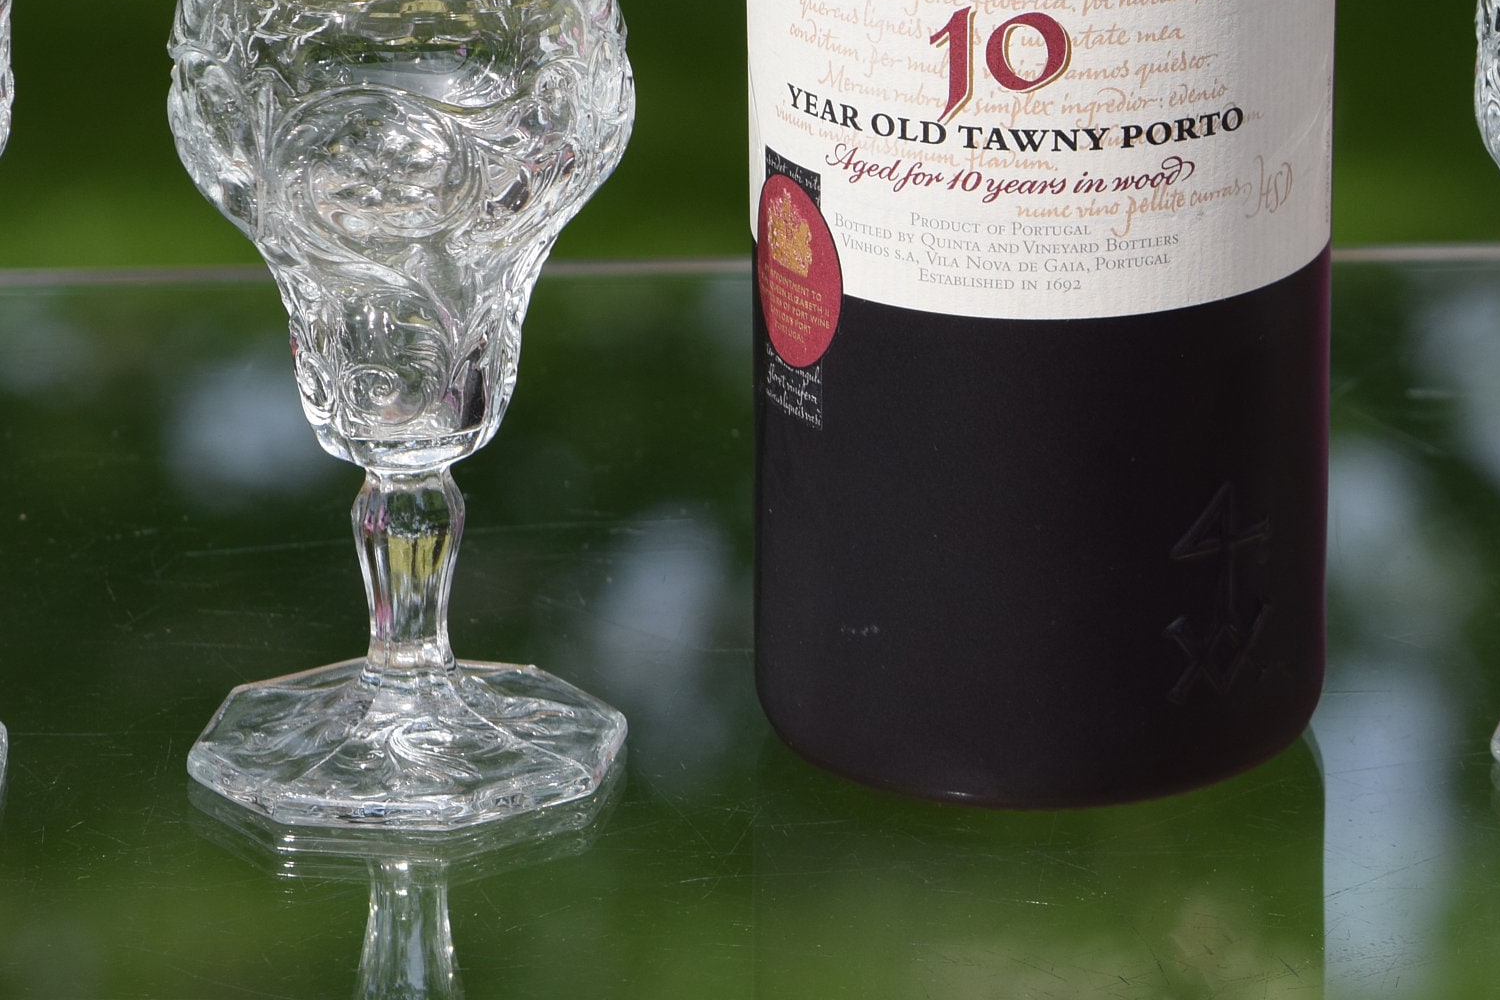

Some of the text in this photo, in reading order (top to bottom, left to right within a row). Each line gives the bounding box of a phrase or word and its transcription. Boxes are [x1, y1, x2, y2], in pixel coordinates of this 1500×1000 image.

[930, 6, 1071, 125] 10
[787, 82, 863, 131] YEAR
[871, 113, 947, 144] OLD
[958, 125, 1110, 152] TAWNY
[1120, 107, 1243, 149] PORTO
[825, 144, 1195, 203] Aged for 10 years in wood
[834, 212, 1179, 254] BOTTLED BY QUINTA AND VINEYARD BOTTLERS
[911, 212, 1091, 236] PRODUCT OF PORTUGAL
[840, 232, 889, 257] VINHOS
[926, 251, 959, 268] VILA
[966, 256, 1011, 272] NOVA
[1018, 262, 1038, 273] DE
[1044, 258, 1090, 274] GAIA,
[1096, 253, 1171, 272] PORTUGAL
[811, 290, 822, 302] TO
[919, 268, 1082, 294] ESTABLISHED IN 1692
[787, 291, 823, 314] ELIZABETH
[811, 313, 830, 329] WINE
